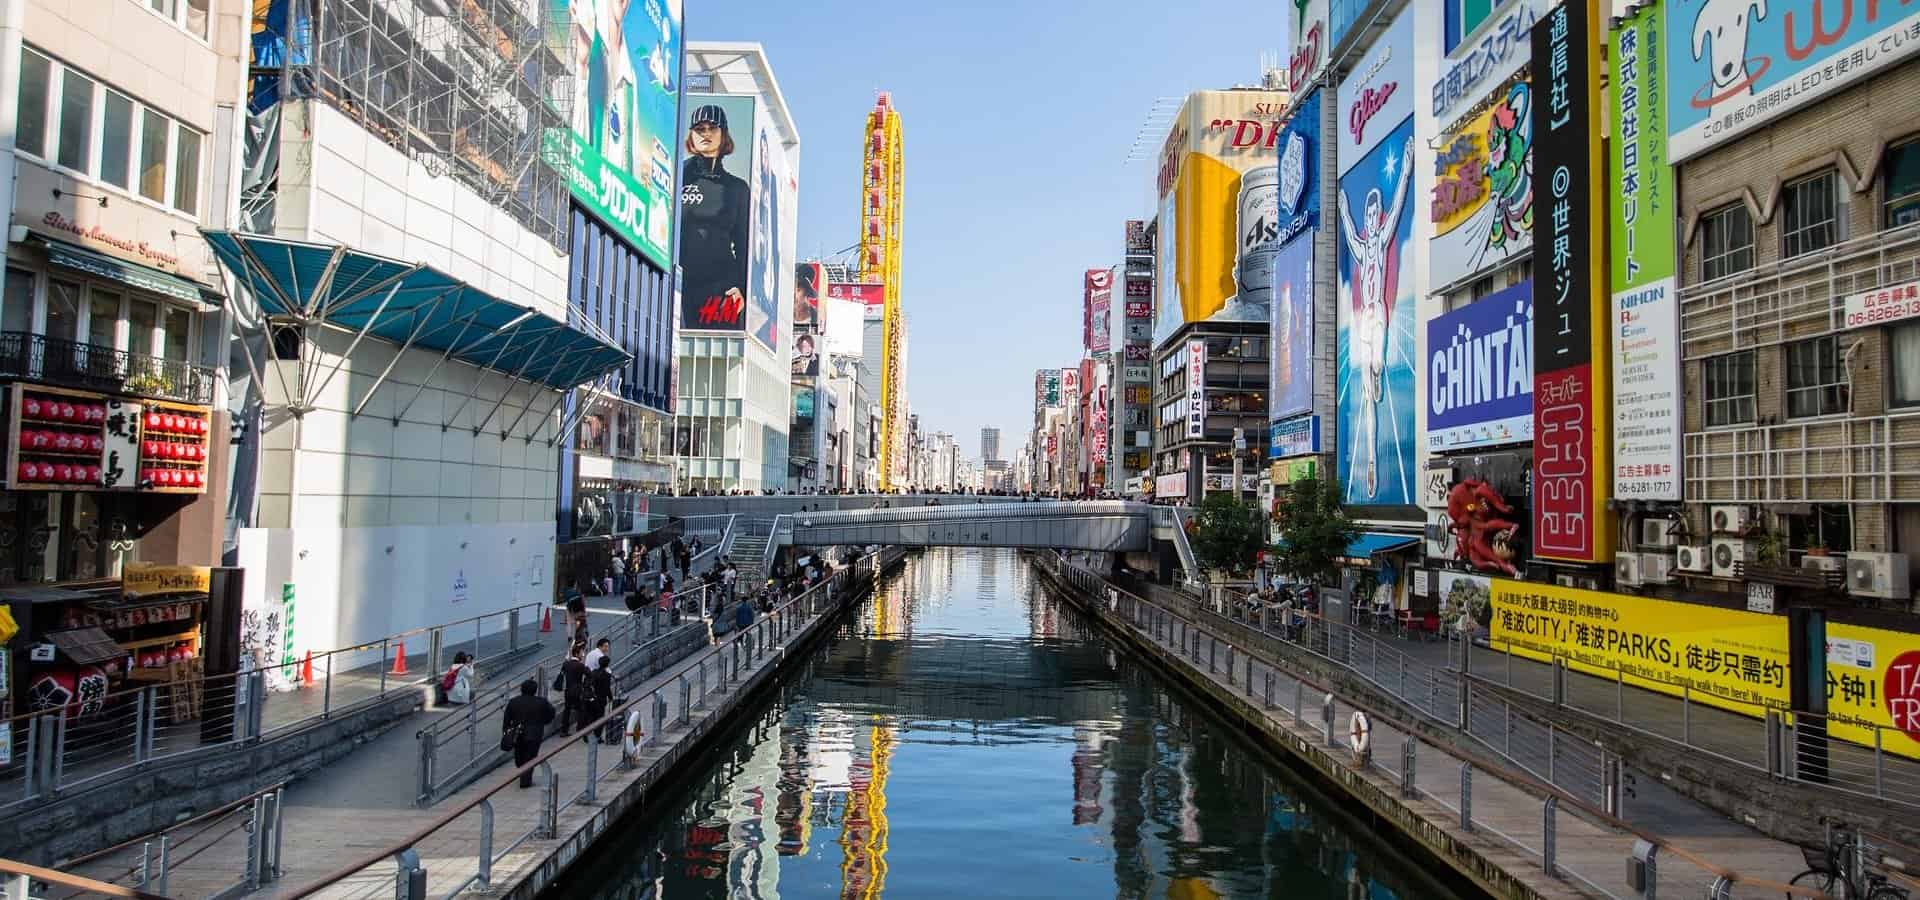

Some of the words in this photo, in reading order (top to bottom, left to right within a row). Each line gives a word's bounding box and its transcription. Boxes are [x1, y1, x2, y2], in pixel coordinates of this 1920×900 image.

[1432, 3, 1537, 117] 日商エステム
[1351, 81, 1397, 145] Glico
[1619, 27, 1639, 282] 株式会社日本リート
[1621, 287, 1664, 309] NIHON
[1539, 403, 1586, 550] 玉出
[1618, 481, 1671, 493] 06-6281-1717
